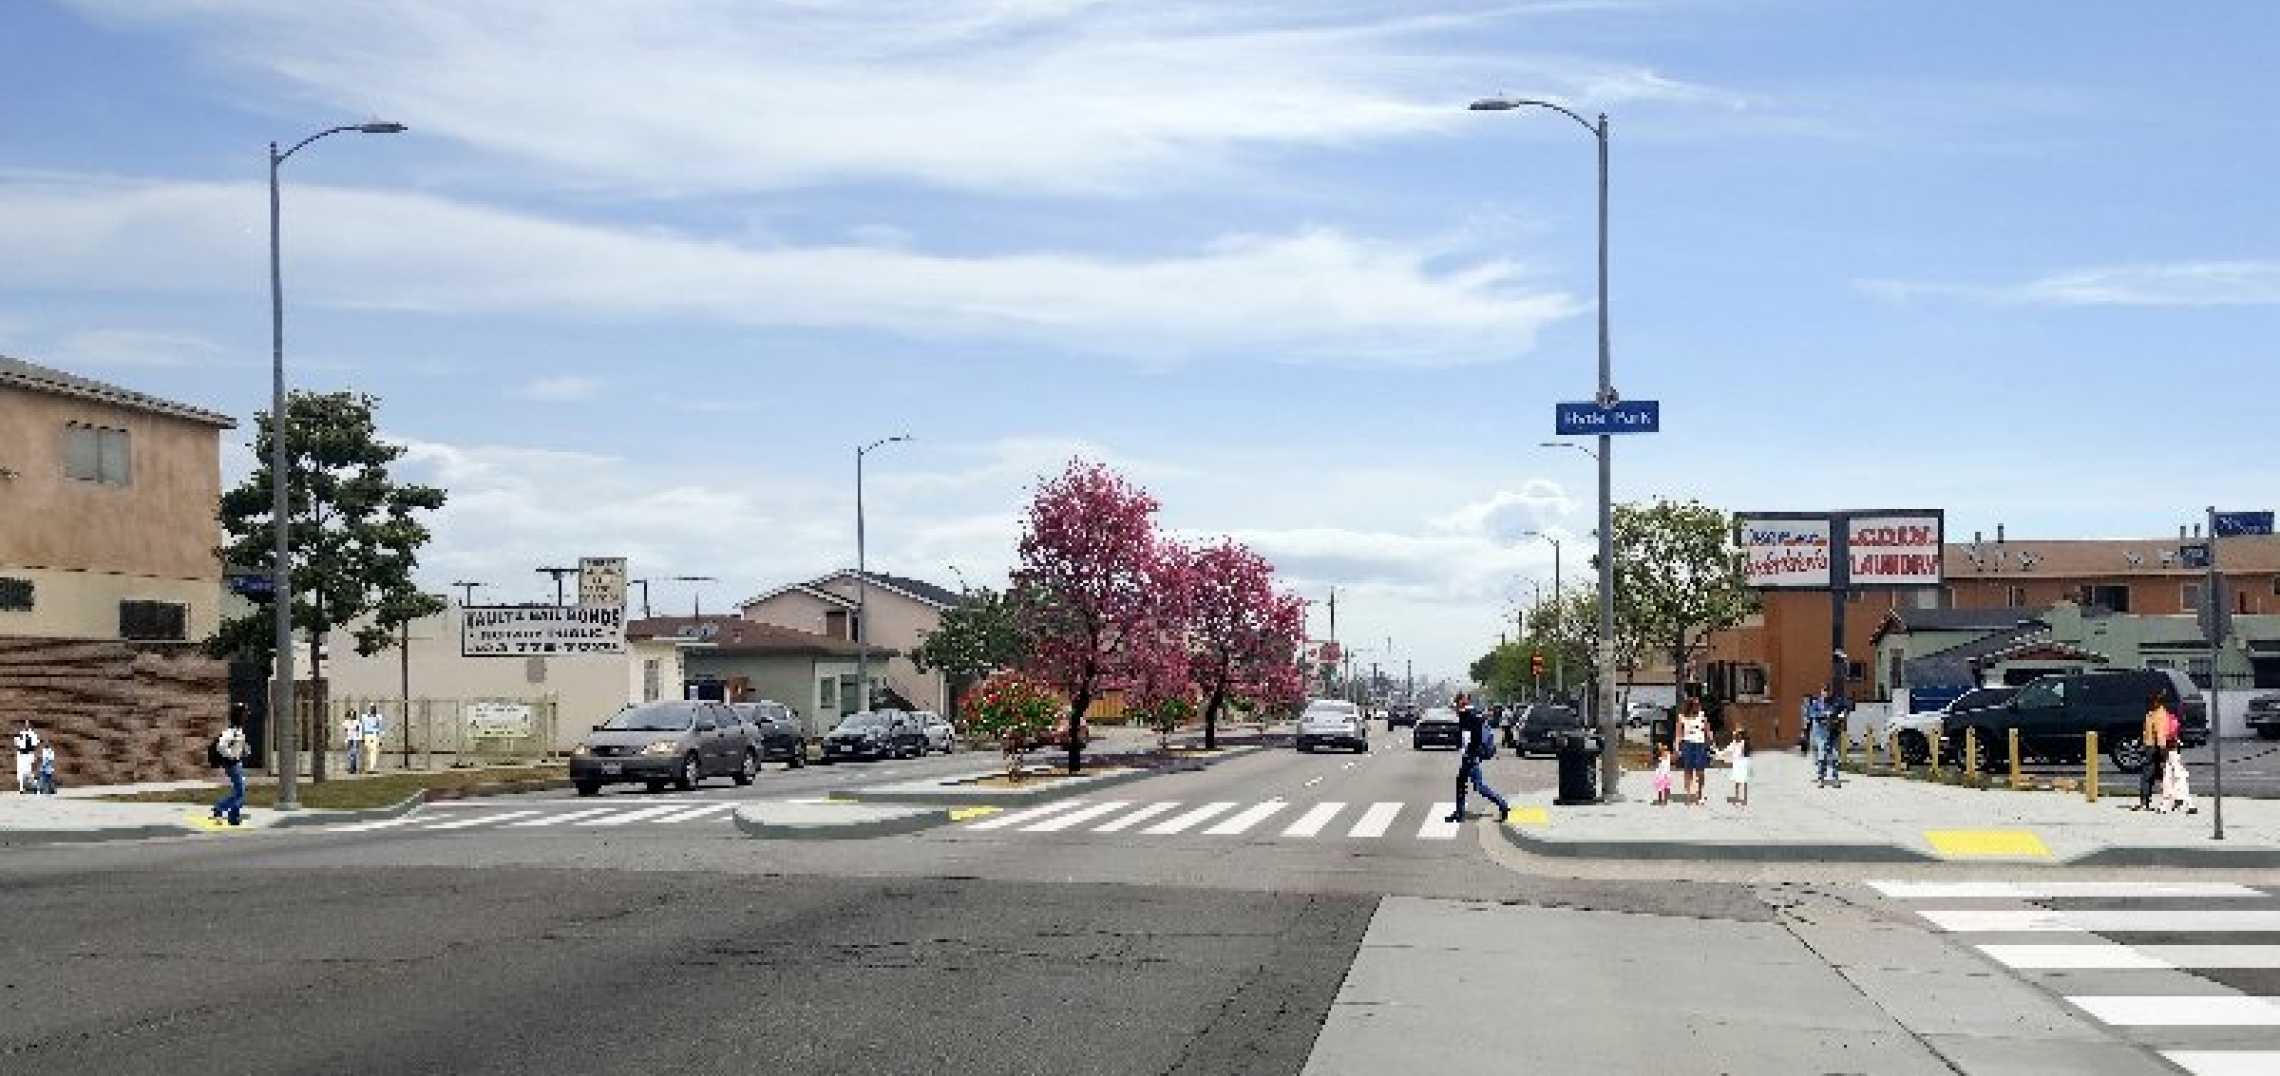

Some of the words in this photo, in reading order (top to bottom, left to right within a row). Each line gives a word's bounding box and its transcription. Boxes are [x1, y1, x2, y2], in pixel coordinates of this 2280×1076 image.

[1564, 411, 1605, 428] Hyde
[1616, 411, 1651, 424] Park
[1857, 525, 1930, 545] COIN
[1850, 554, 1938, 575] LAUNDRY
